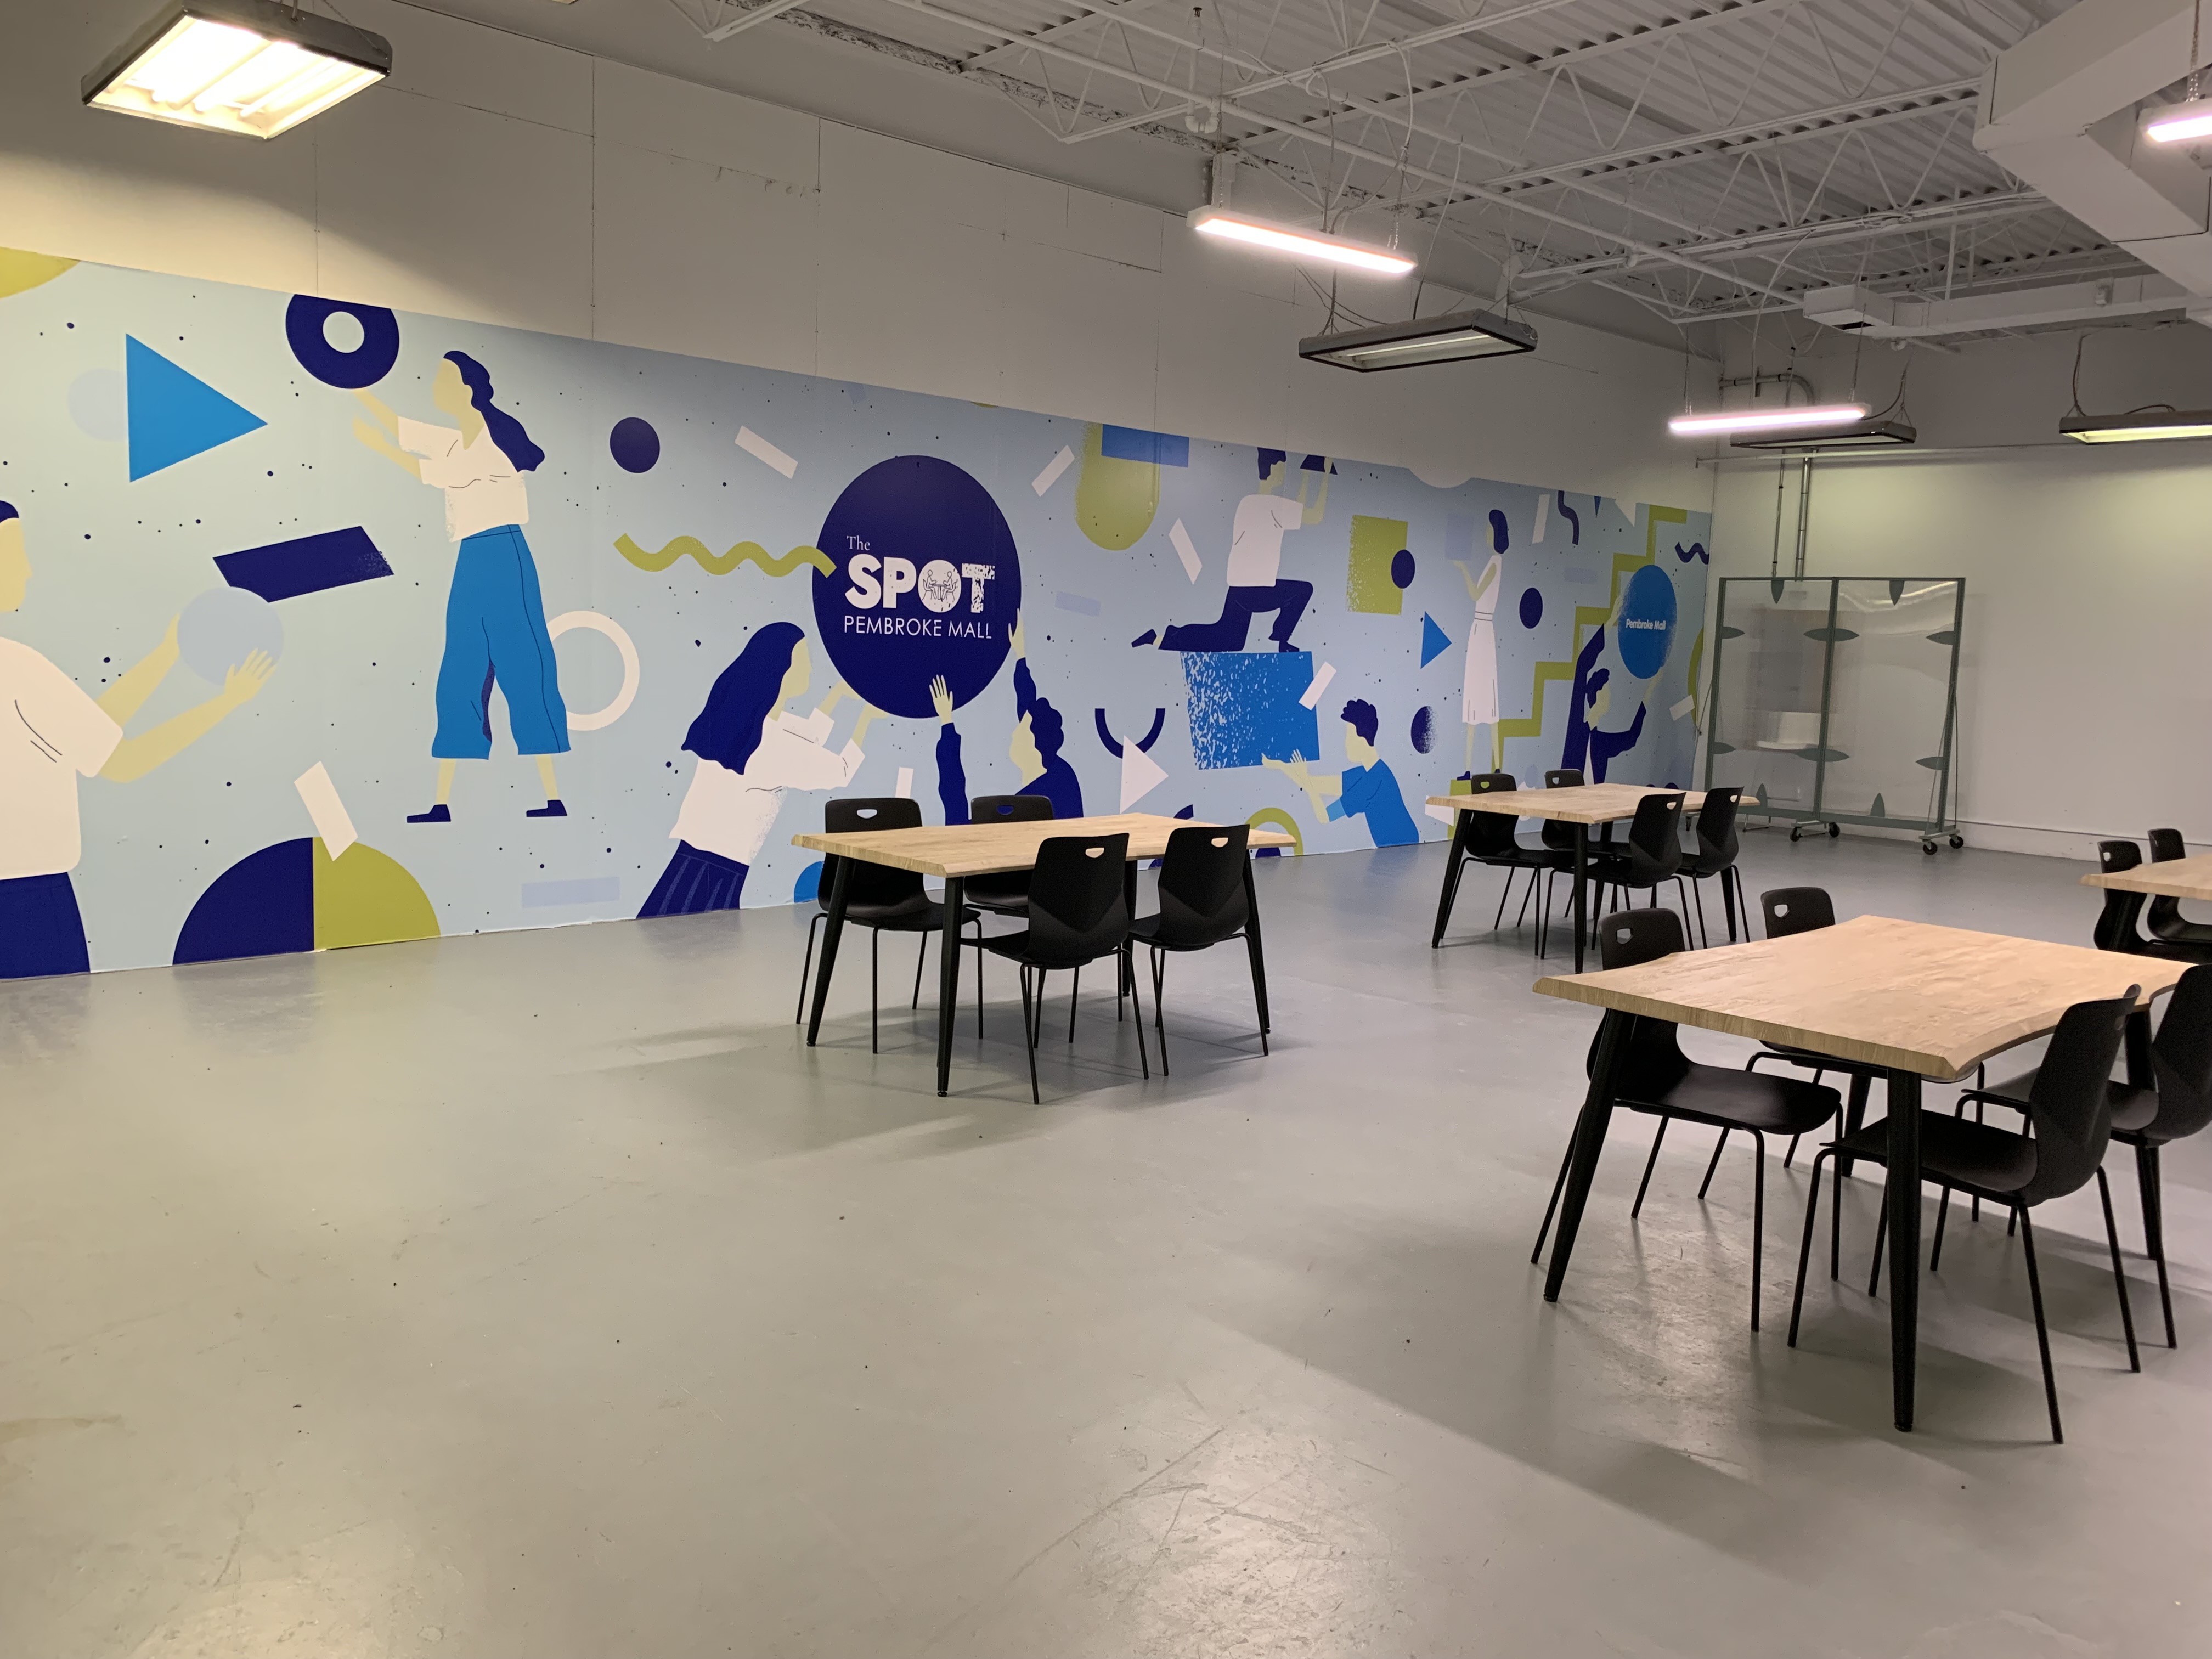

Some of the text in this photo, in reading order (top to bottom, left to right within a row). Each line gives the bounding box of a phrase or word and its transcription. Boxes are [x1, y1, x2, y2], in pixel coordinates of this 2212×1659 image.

[847, 535, 870, 550] The
[845, 553, 995, 613] SPOT
[844, 615, 992, 639] PEMBROKE MALL
[1626, 619, 1666, 630] Pembroke Mall
